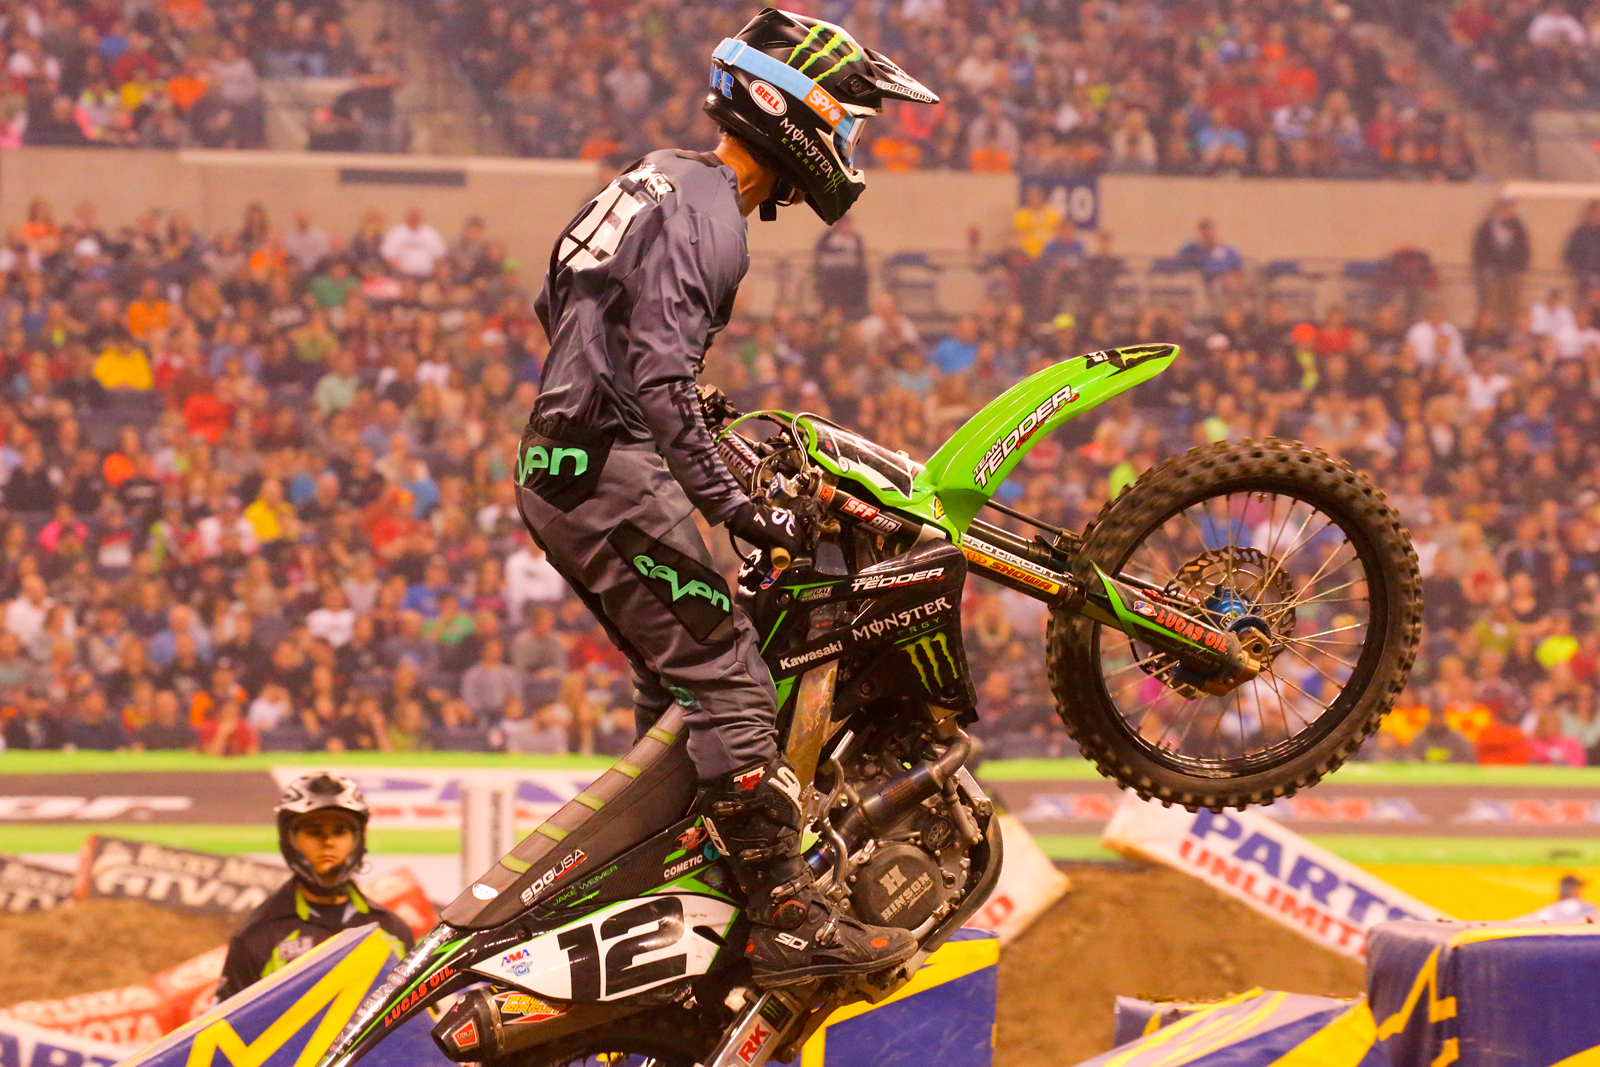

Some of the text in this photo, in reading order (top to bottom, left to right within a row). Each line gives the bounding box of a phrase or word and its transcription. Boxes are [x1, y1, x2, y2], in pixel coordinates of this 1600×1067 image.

[754, 85, 780, 111] BELL
[780, 117, 834, 178] MONSTER
[781, 137, 821, 176] ENERGY
[973, 437, 1002, 475] TEAM
[974, 384, 1072, 489] TEDDER
[844, 499, 875, 518] SFF
[851, 567, 945, 592] TEDDER
[853, 574, 884, 583] TEAM
[989, 561, 1053, 591] SHOWA
[851, 597, 953, 641] MONSTER
[1155, 609, 1205, 641] LUCAS
[1204, 632, 1229, 653] OIL
[779, 640, 844, 671] Kawasaki
[553, 888, 577, 906] JAKE
[578, 865, 618, 891] WEIMER
[663, 854, 703, 878] COMETIC
[880, 872, 930, 921] HINSON
[1179, 840, 1367, 955] UNLIMIT
[500, 949, 531, 966] AMA
[557, 896, 688, 1000] 12
[384, 964, 454, 1027] LUCAS OIL
[738, 1023, 770, 1063] RK
